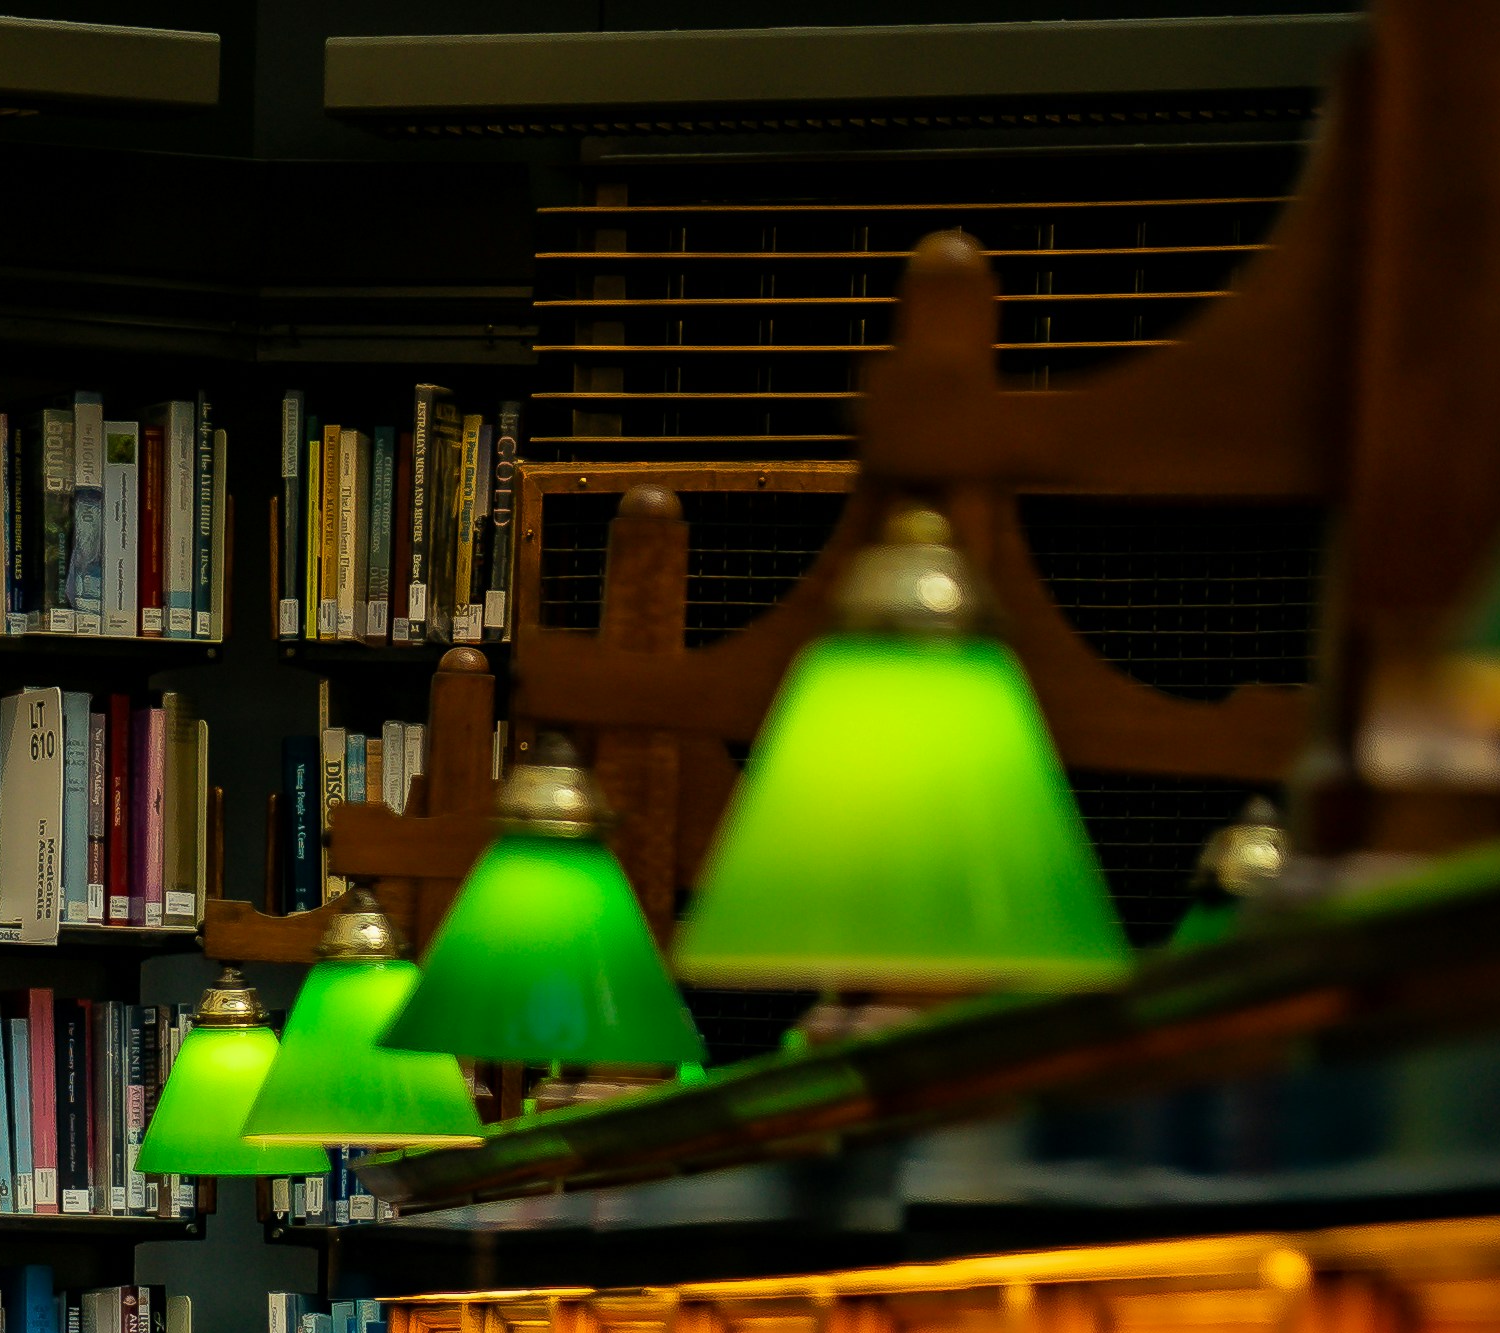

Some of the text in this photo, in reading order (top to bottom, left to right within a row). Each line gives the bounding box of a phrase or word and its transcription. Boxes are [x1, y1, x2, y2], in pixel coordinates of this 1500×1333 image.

[30, 700, 45, 728] LT
[31, 732, 54, 761] 610
[37, 840, 46, 920] Australia
[45, 839, 54, 919] Medicine
